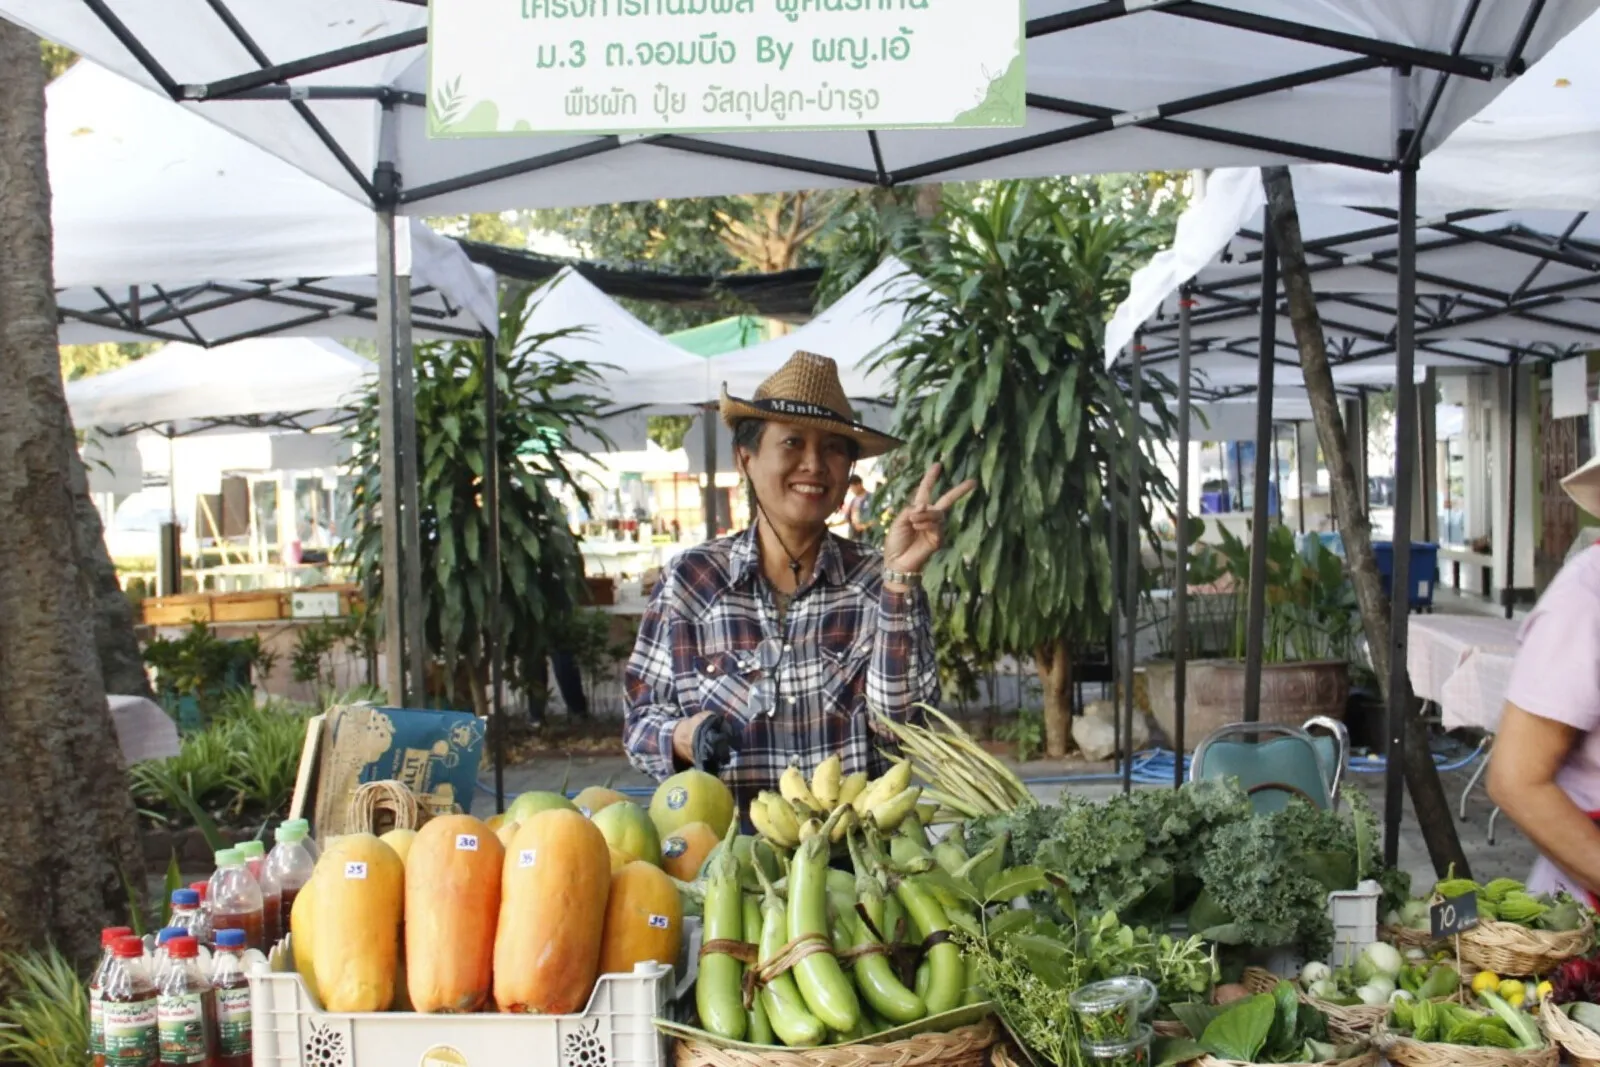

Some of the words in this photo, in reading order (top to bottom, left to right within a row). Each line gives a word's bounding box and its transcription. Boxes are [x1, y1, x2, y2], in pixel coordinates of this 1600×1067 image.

[536, 40, 586, 68] ม.3
[606, 32, 736, 67] ต.จอมบึง
[756, 36, 793, 70] By
[812, 26, 914, 70] ผญ.เอ้
[565, 86, 636, 116] พืชผัก
[654, 82, 686, 122] ปุ๋ย
[702, 82, 879, 121] วัสดุปลูก-บำรุง
[1439, 904, 1456, 931] 10
